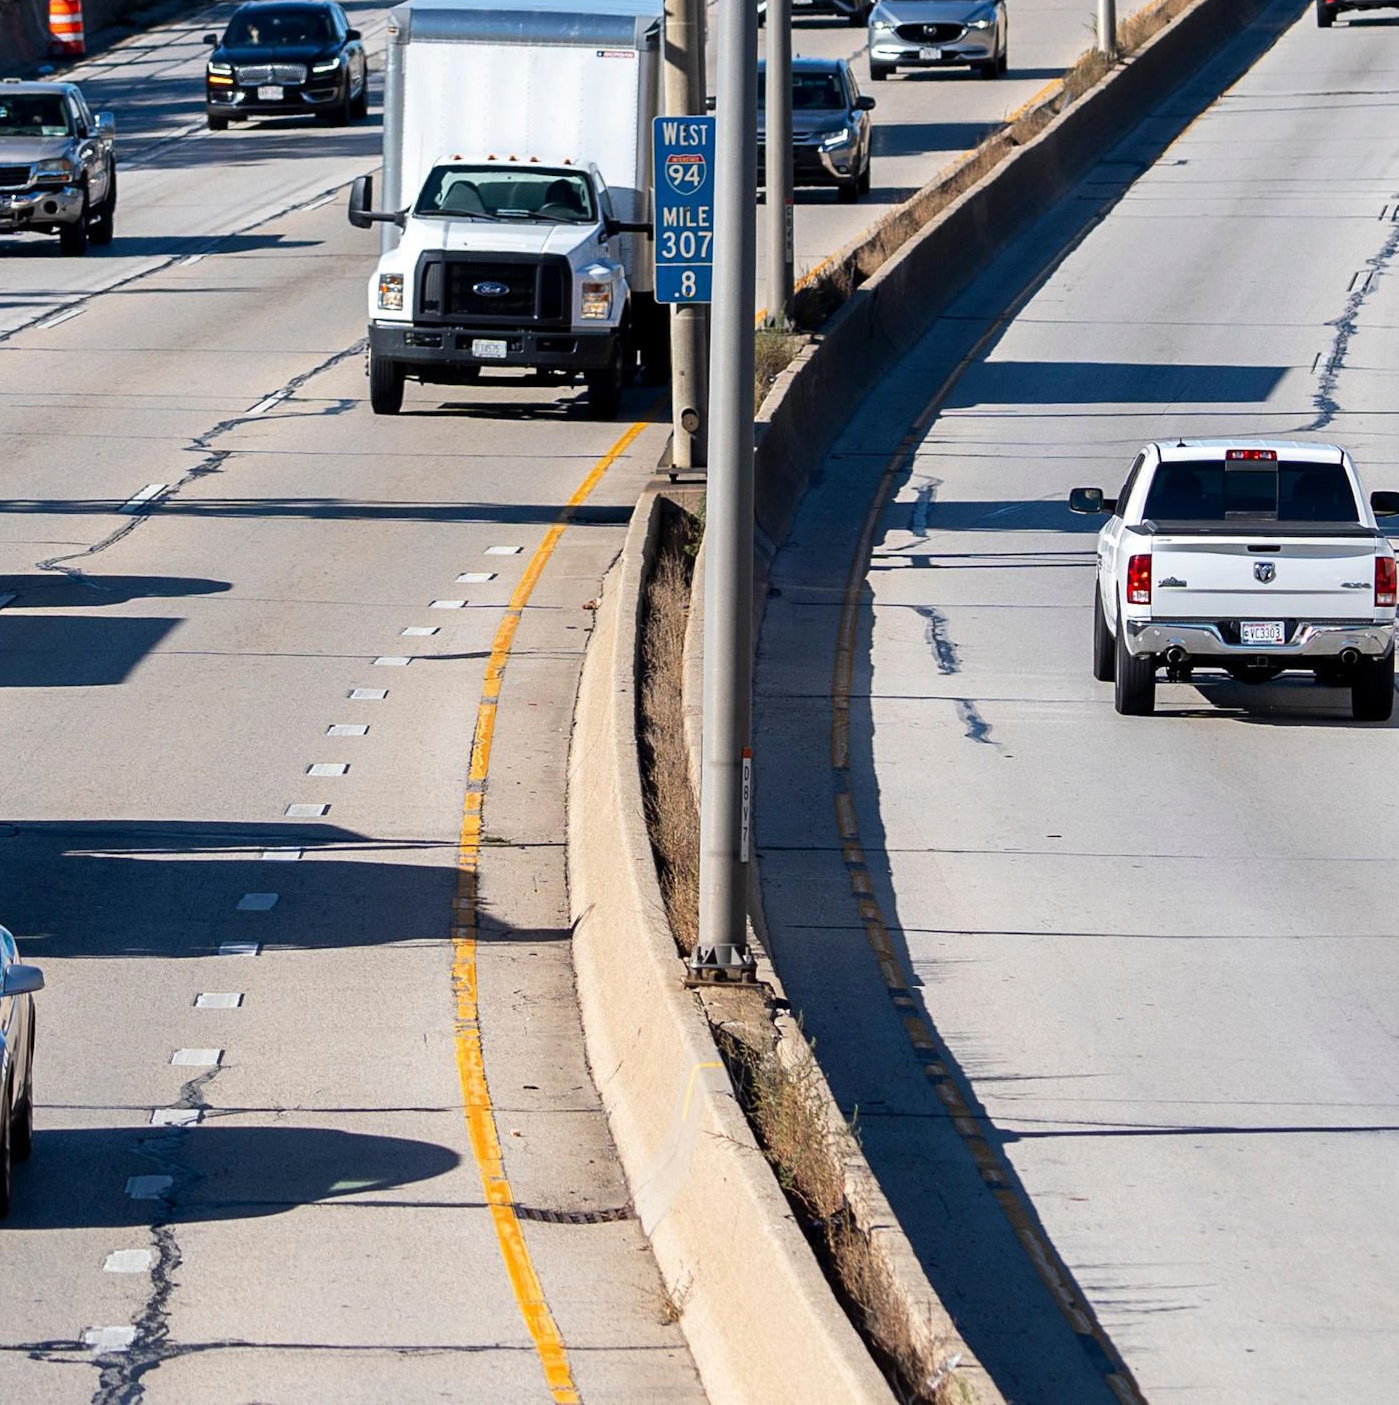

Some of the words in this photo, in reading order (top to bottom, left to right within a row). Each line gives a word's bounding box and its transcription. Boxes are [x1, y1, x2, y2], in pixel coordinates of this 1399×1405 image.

[662, 122, 708, 146] WEST
[668, 164, 700, 187] 94
[663, 206, 710, 228] MILE
[661, 231, 713, 259] 307
[1251, 628, 1281, 639] VC3303
